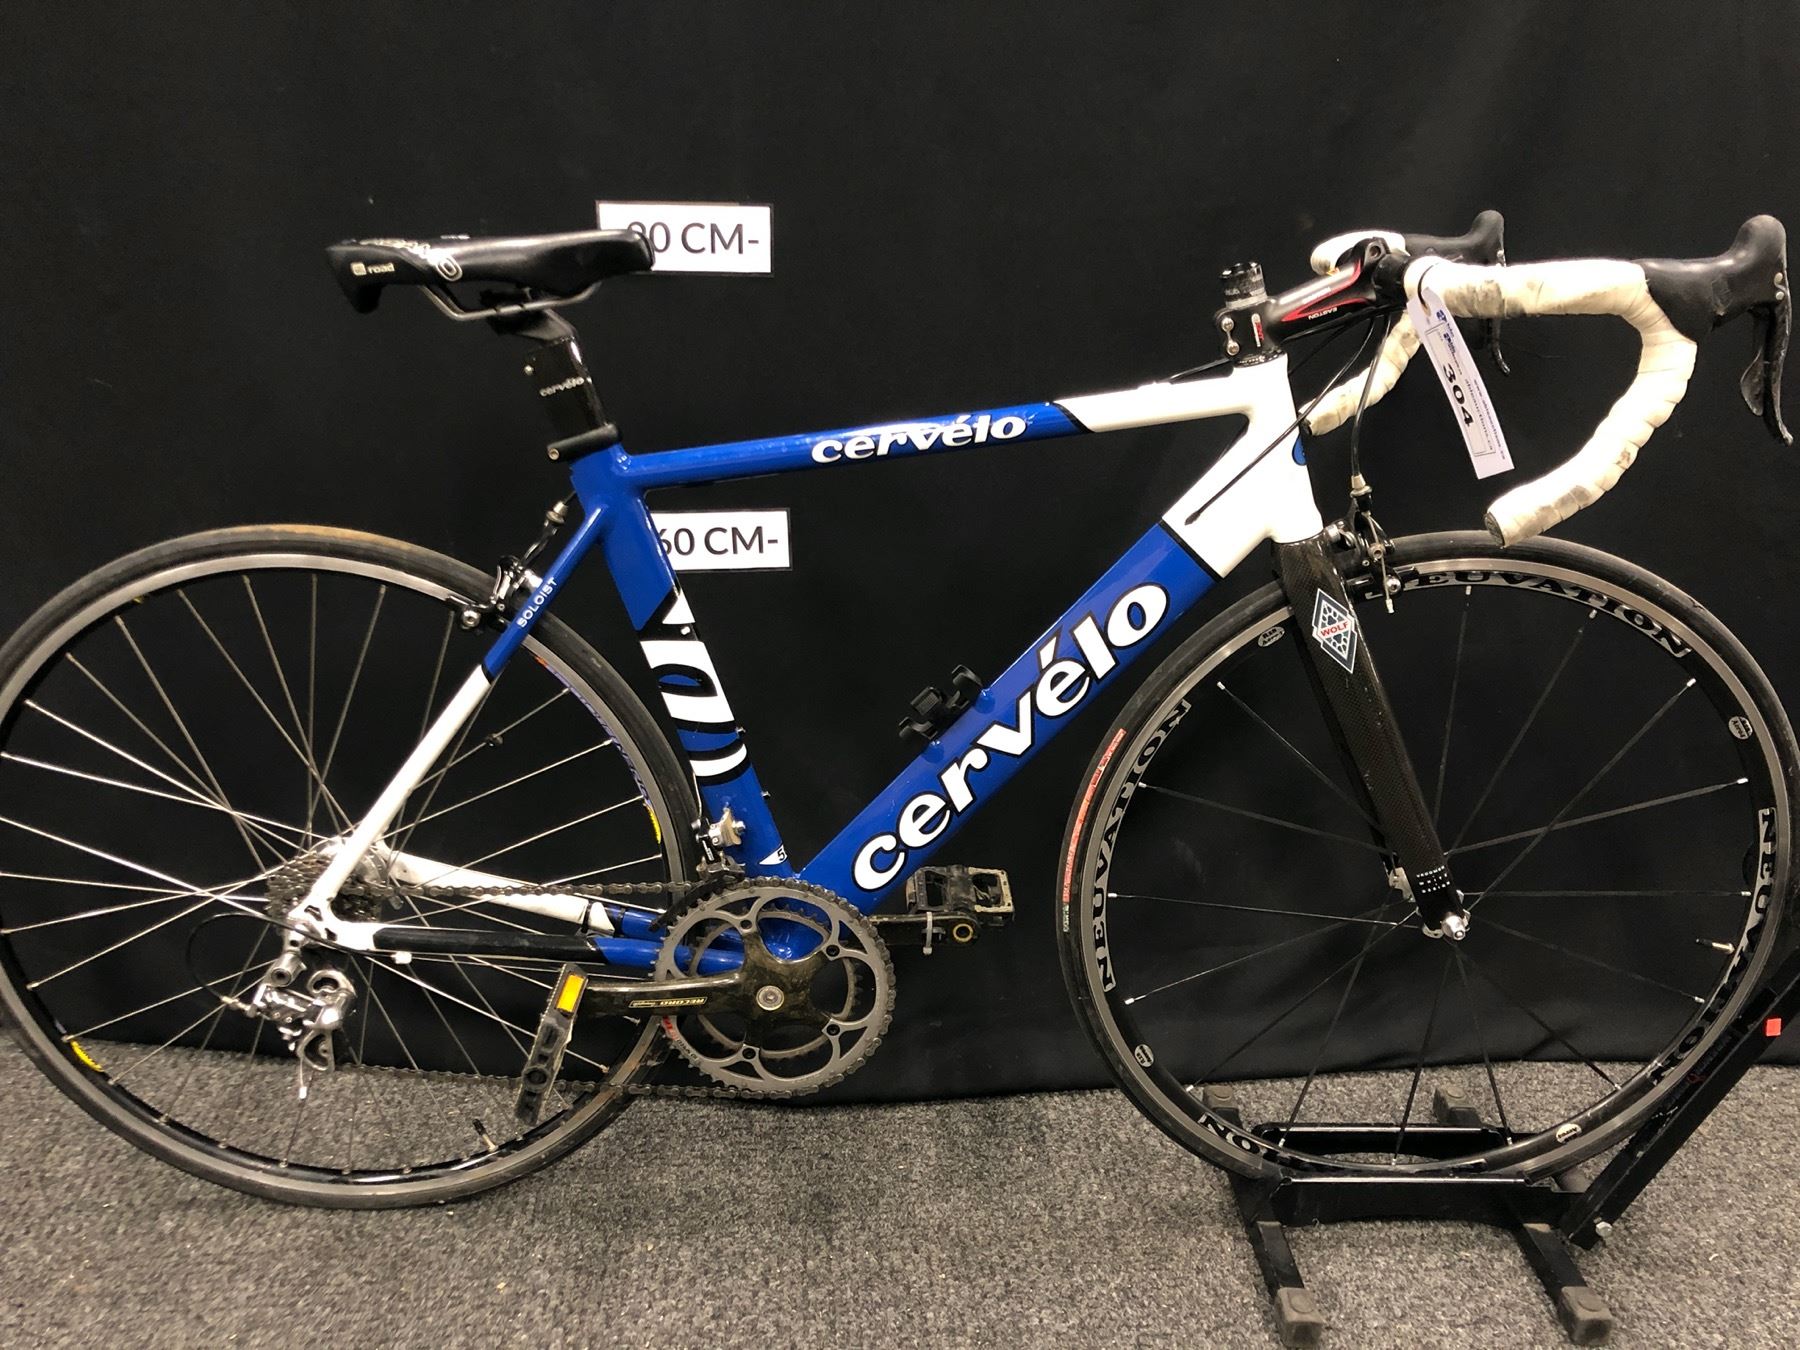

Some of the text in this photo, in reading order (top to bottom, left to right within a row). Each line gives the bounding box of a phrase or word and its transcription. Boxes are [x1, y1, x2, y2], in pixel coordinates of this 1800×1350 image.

[681, 222, 759, 254] CM-
[367, 262, 396, 274] road
[1308, 307, 1338, 320] EASTON
[1443, 364, 1474, 427] 304
[811, 415, 1027, 464] cervélo
[704, 525, 779, 556] CM-
[516, 576, 557, 628] SOLOIST
[1320, 621, 1349, 637] WOLF
[852, 583, 1169, 892] cervélo
[1092, 700, 1190, 990] NEUVATION
